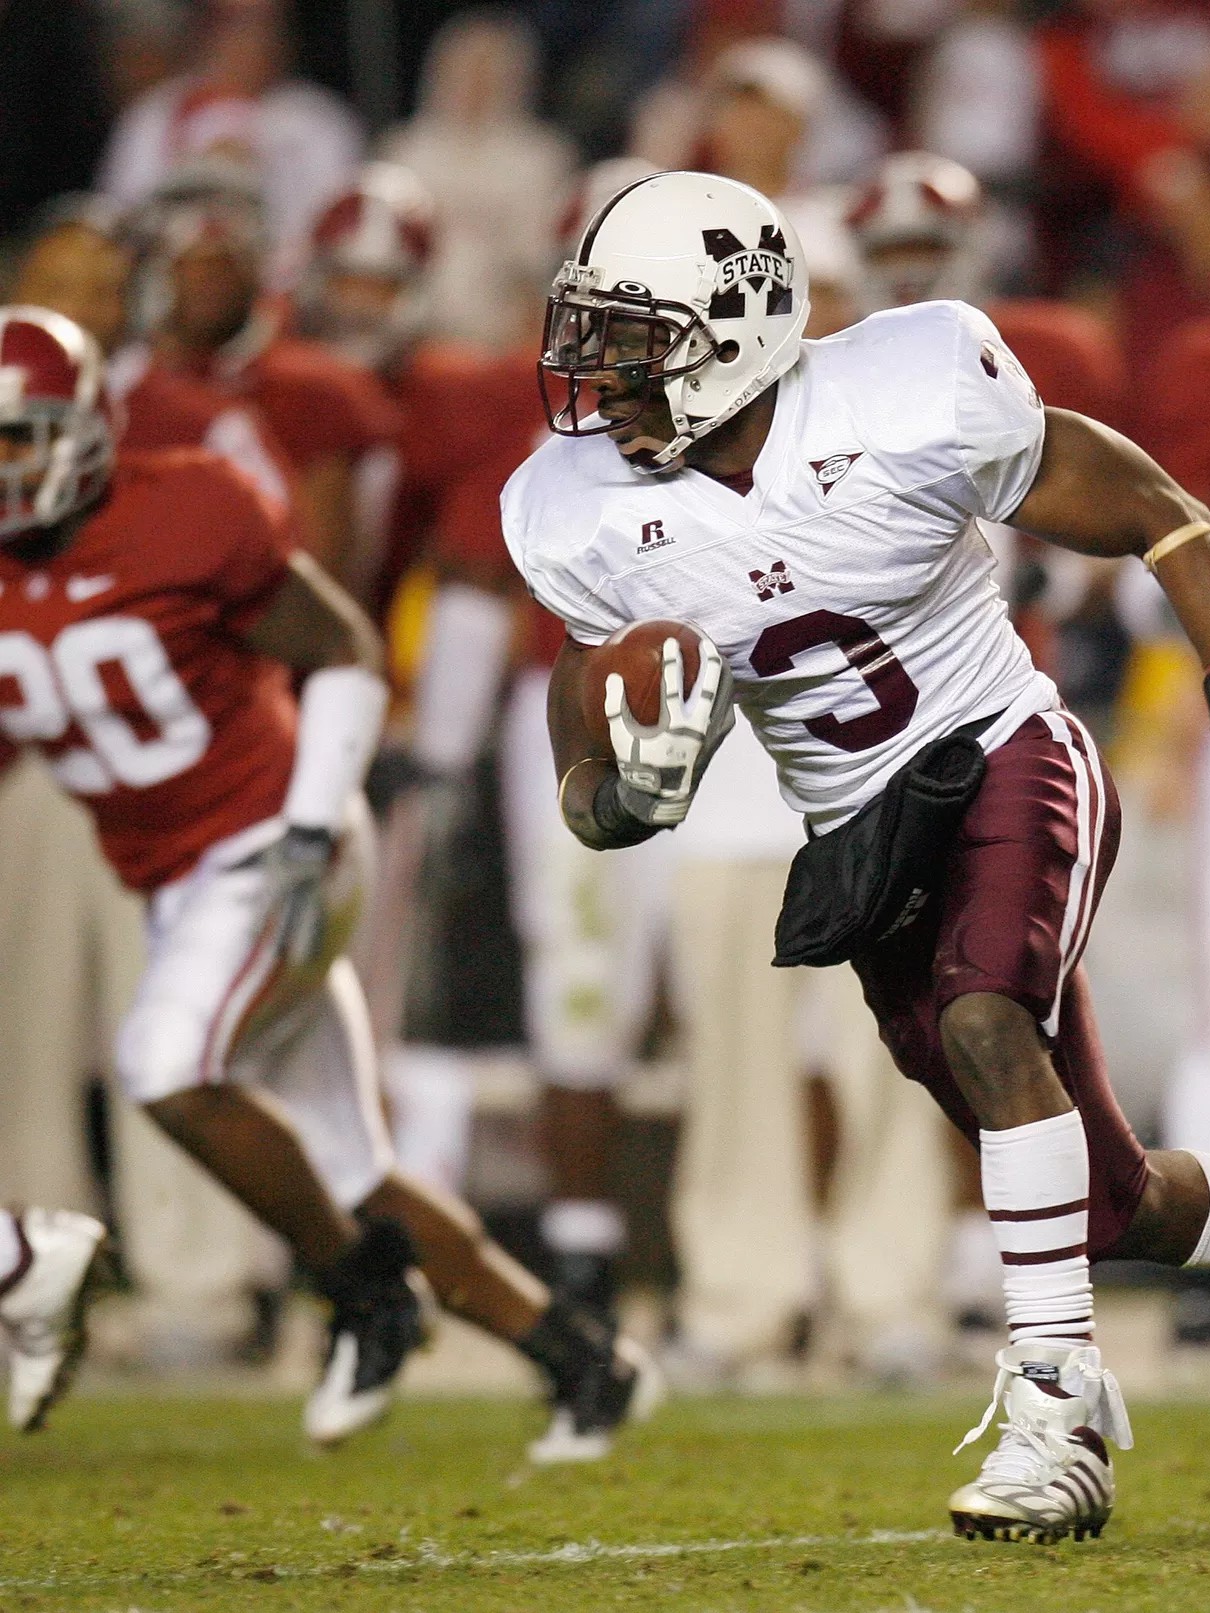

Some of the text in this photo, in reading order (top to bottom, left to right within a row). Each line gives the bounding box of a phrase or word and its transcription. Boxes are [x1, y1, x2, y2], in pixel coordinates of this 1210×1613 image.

[722, 253, 784, 285] STATE
[822, 464, 846, 478] SEC
[642, 519, 665, 545] R
[637, 537, 677, 555] RUSSELL
[759, 573, 787, 589] STATE
[748, 608, 919, 753] 3
